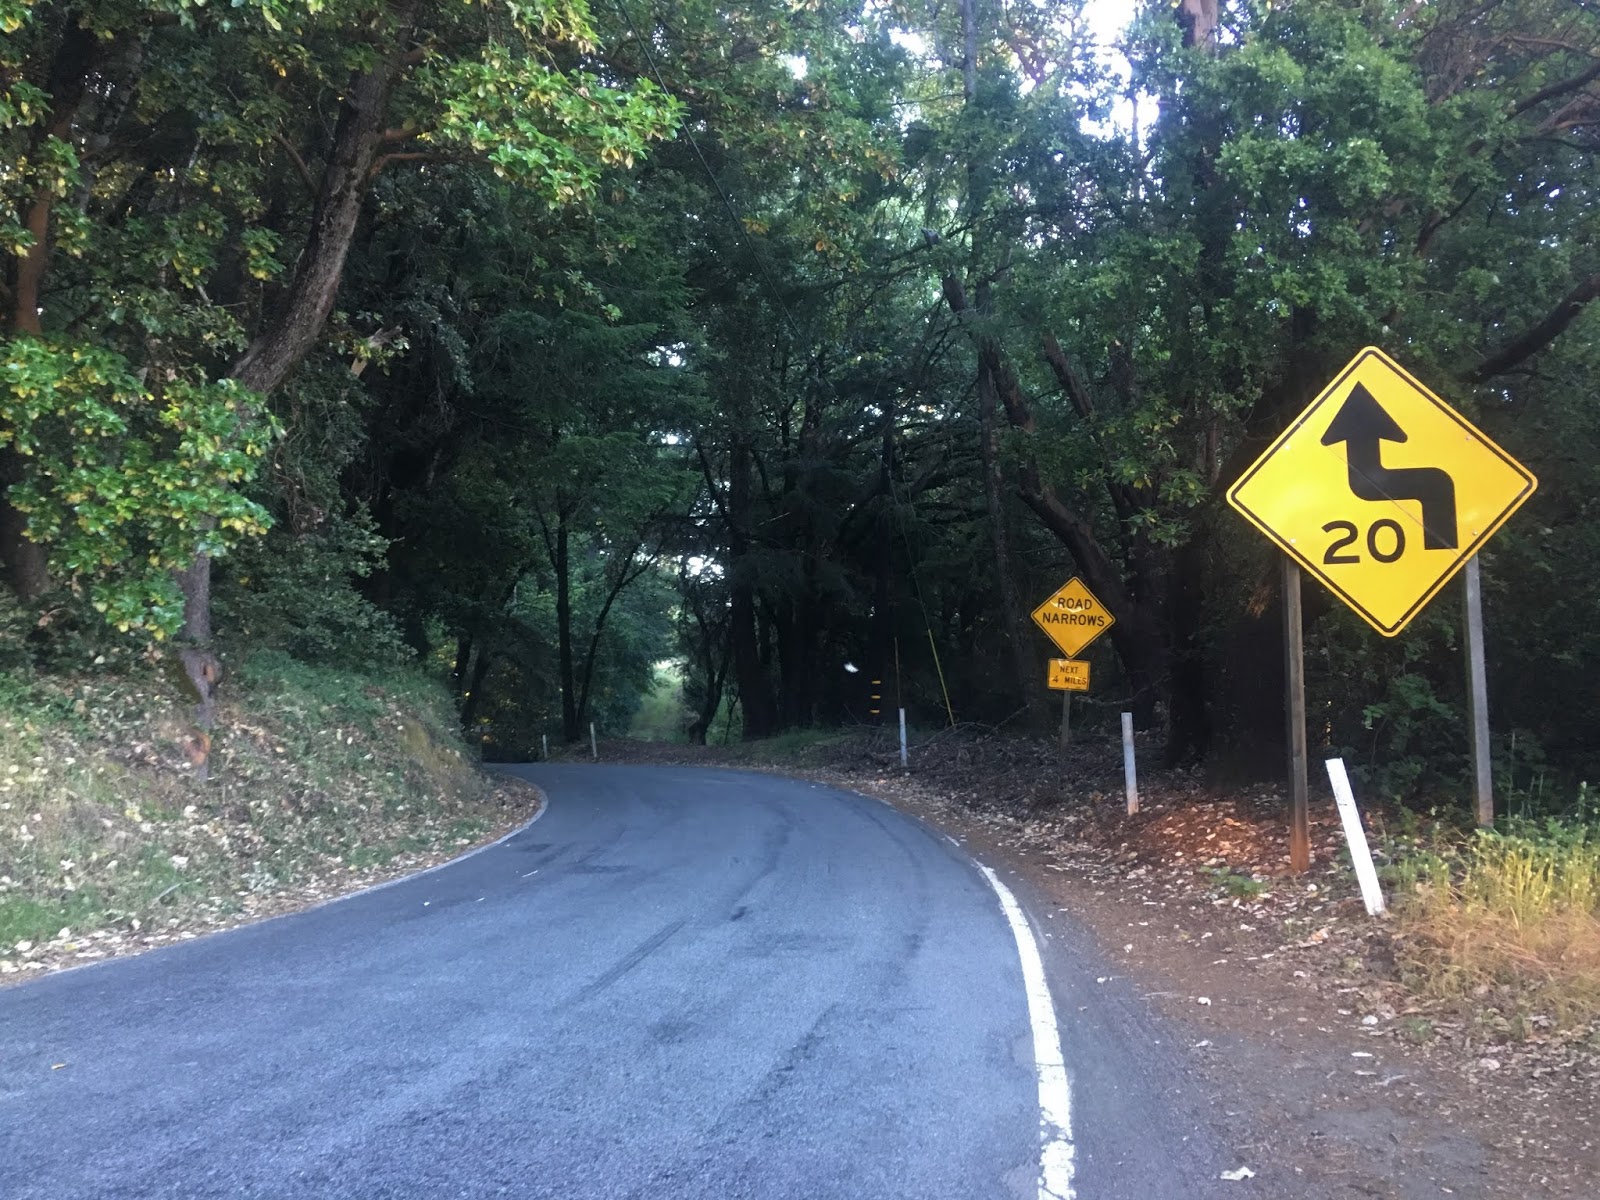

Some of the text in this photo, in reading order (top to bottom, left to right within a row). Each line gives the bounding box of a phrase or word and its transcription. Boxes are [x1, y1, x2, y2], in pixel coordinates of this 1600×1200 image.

[1321, 518, 1406, 564] 20
[1057, 597, 1093, 610] ROAD
[1042, 612, 1105, 627] NARROWS
[1060, 665, 1079, 674] NEXT
[1064, 676, 1087, 685] MILES
